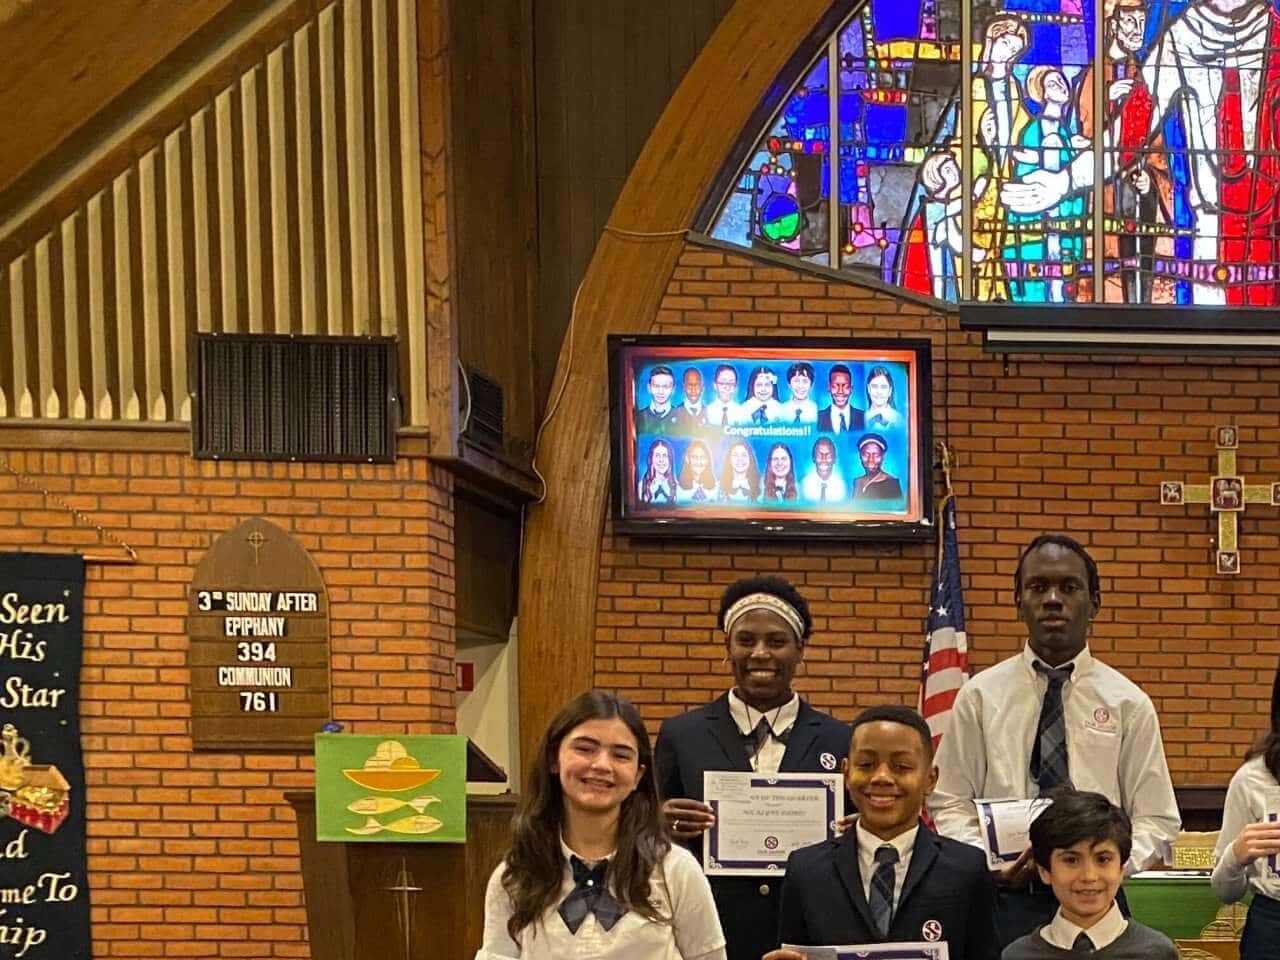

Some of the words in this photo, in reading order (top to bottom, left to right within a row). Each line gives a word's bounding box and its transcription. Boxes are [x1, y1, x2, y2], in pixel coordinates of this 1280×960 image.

[0, 592, 70, 624] Seen
[226, 592, 272, 612] SUNDAY
[277, 592, 317, 612] AFTER
[225, 617, 284, 636] EPIPHANY
[0, 629, 47, 662] His
[237, 642, 276, 662] 394
[219, 667, 292, 687] COMMUNION
[0, 676, 66, 708] Star
[240, 692, 276, 711] 761
[37, 872, 78, 902] To
